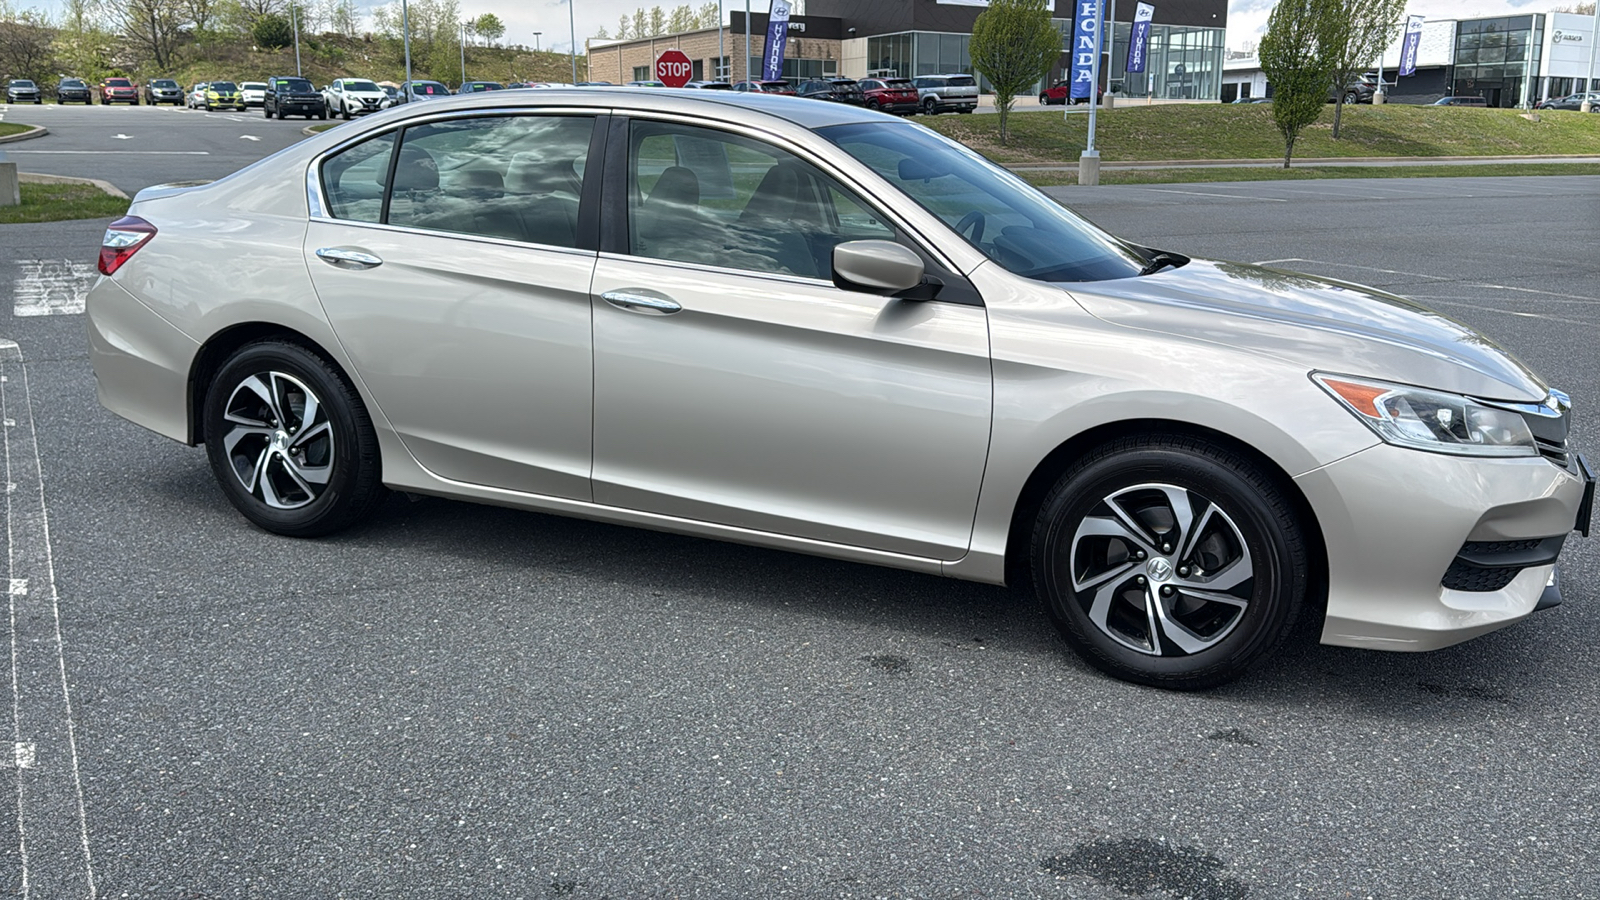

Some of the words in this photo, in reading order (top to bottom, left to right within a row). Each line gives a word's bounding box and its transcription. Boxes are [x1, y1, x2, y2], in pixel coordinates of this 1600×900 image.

[658, 61, 691, 77] STOP
[769, 23, 783, 79] HYUNDAI
[1133, 23, 1146, 71] HYUNDAI
